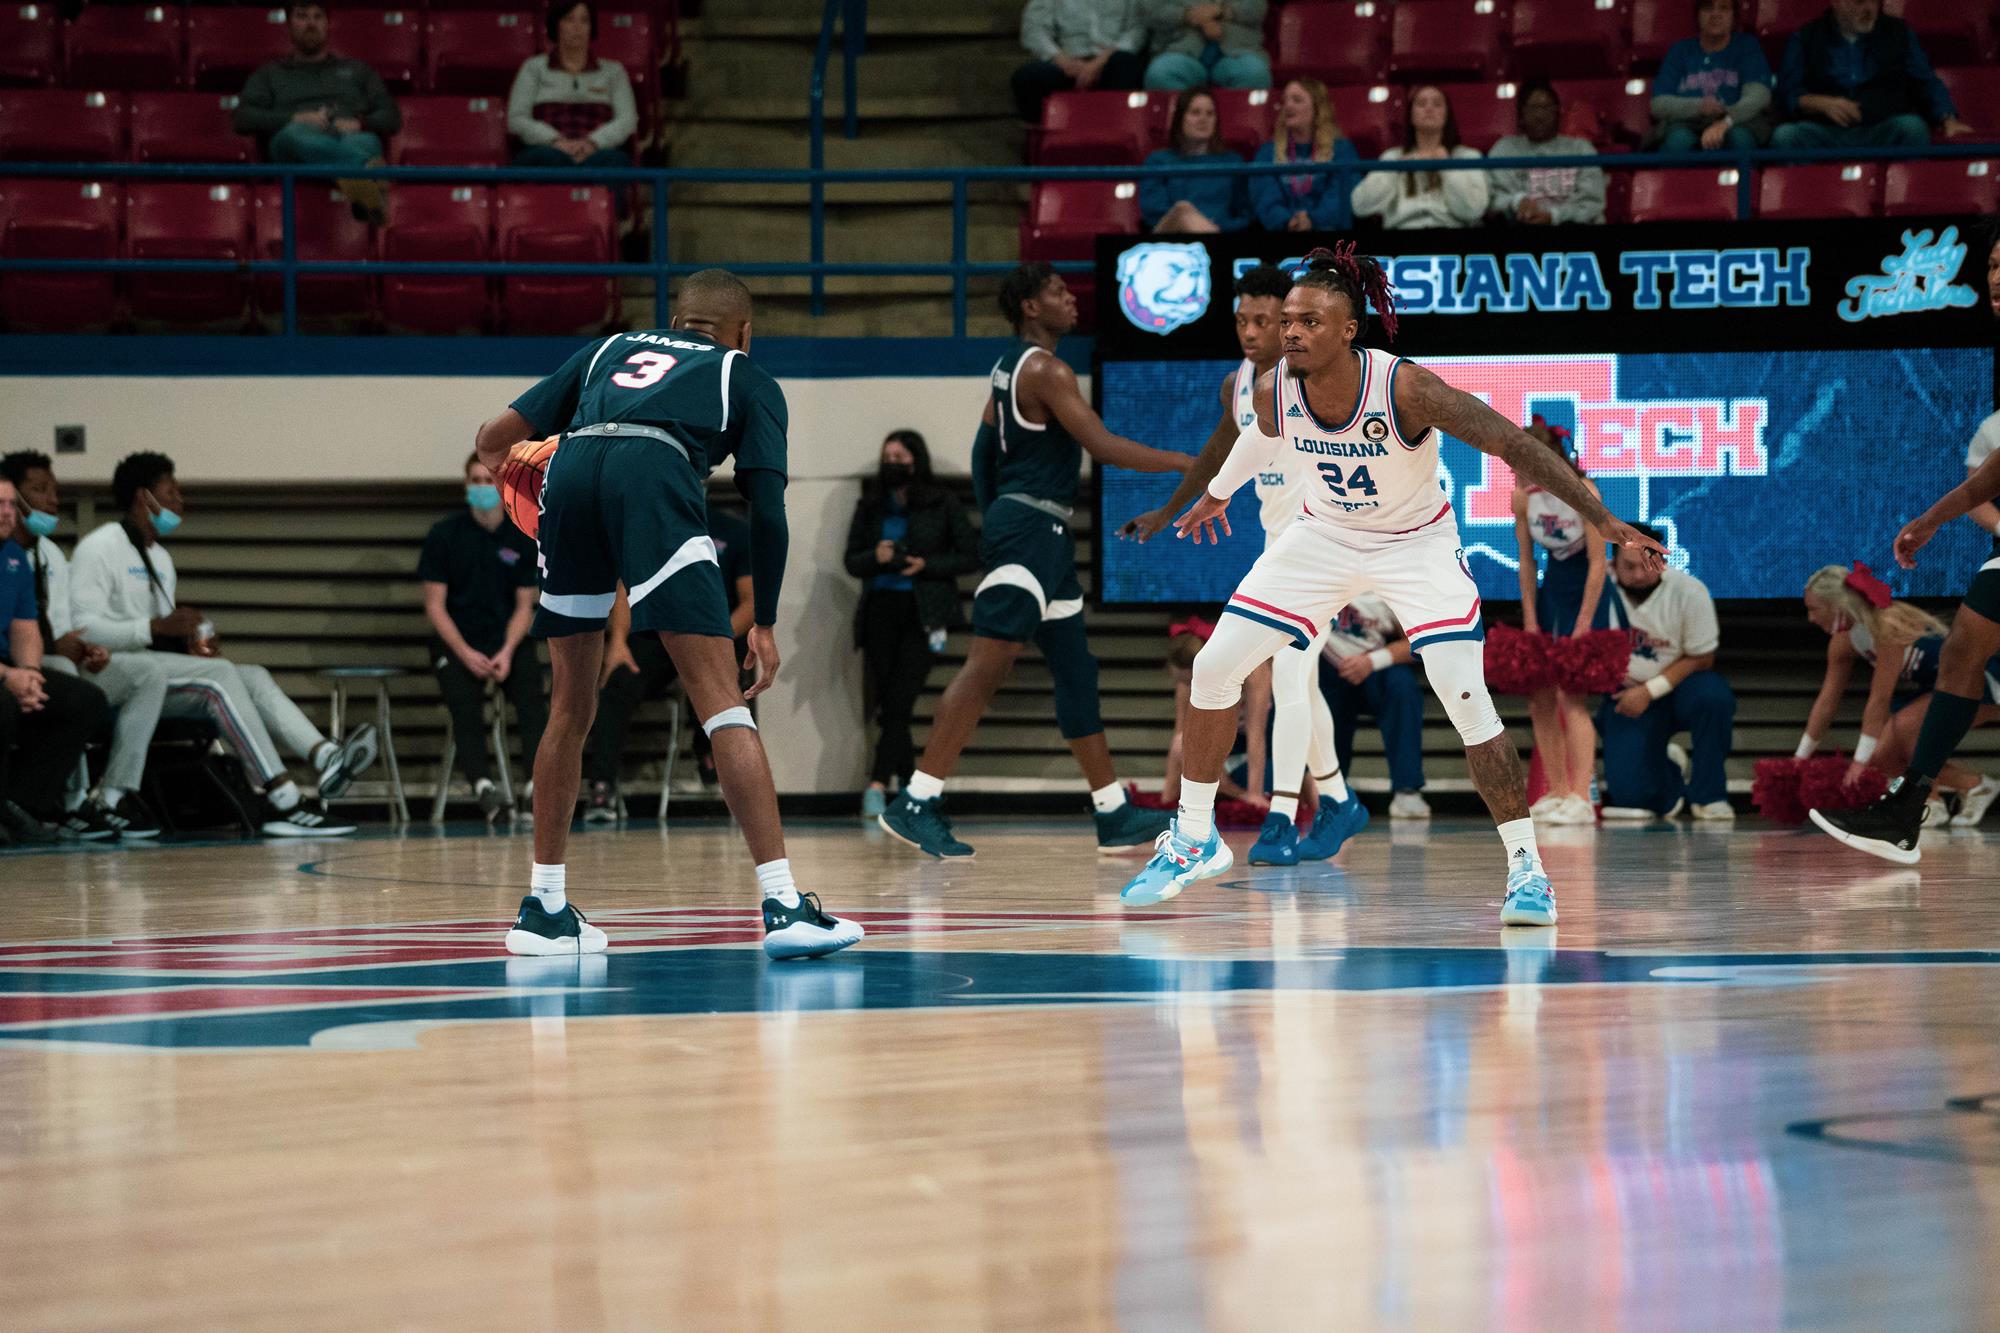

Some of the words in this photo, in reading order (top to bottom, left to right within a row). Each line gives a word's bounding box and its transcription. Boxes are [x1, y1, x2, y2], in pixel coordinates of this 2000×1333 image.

[1619, 248, 1810, 309] TECH
[625, 333, 715, 351] JAMES
[611, 351, 678, 389] 3
[1294, 436, 1389, 458] LOUISIANA
[1316, 462, 1378, 496] 24
